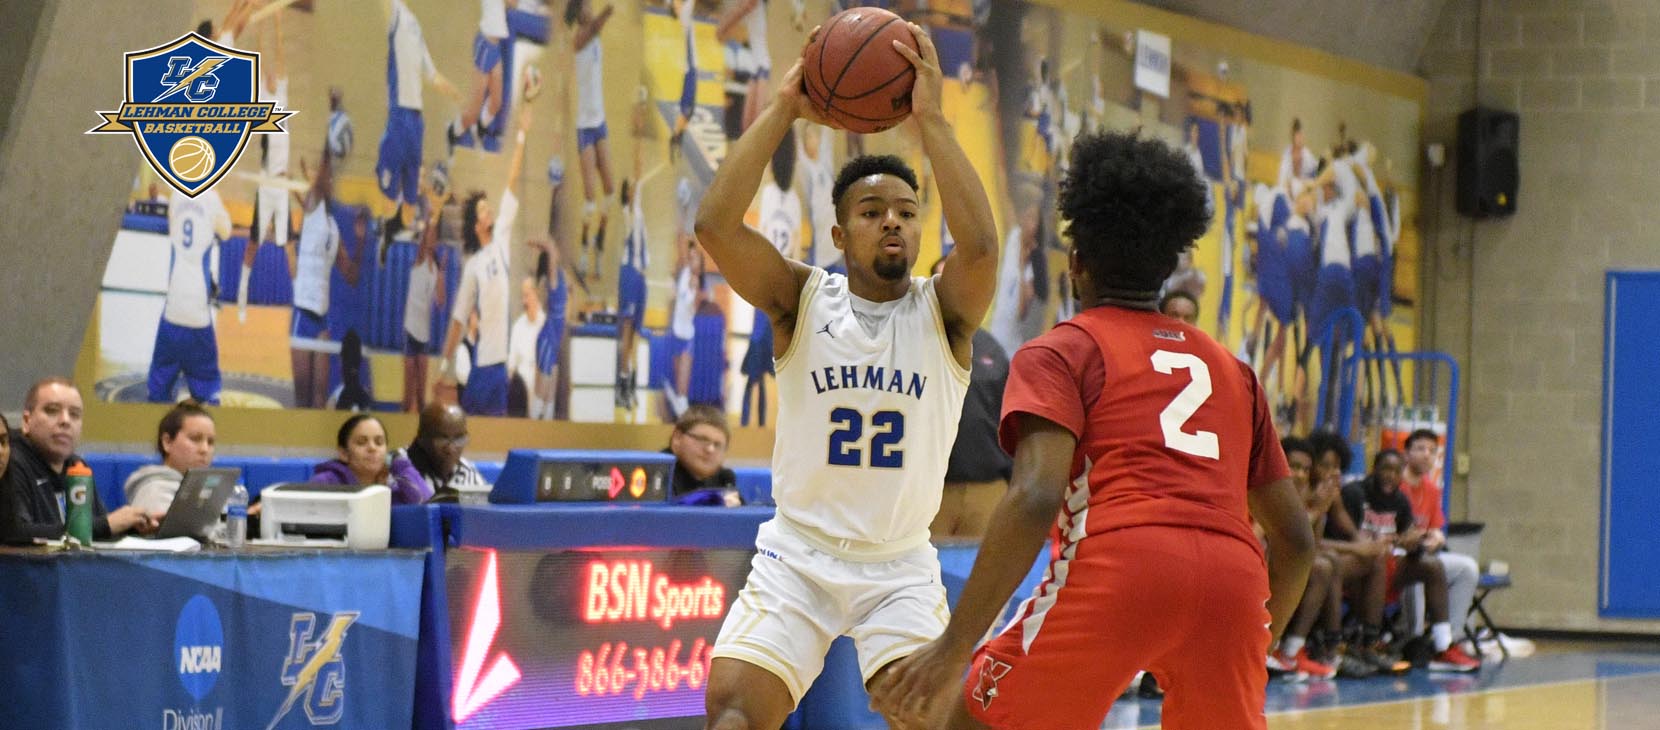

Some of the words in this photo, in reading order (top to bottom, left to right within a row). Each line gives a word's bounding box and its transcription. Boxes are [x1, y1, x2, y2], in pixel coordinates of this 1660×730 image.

[182, 217, 194, 250] 9
[810, 365, 928, 400] LEHMAN
[1150, 349, 1220, 460] 2
[827, 406, 906, 469] 22
[586, 562, 653, 622] BSN
[653, 574, 724, 629] Sports
[180, 645, 222, 675] NCAA
